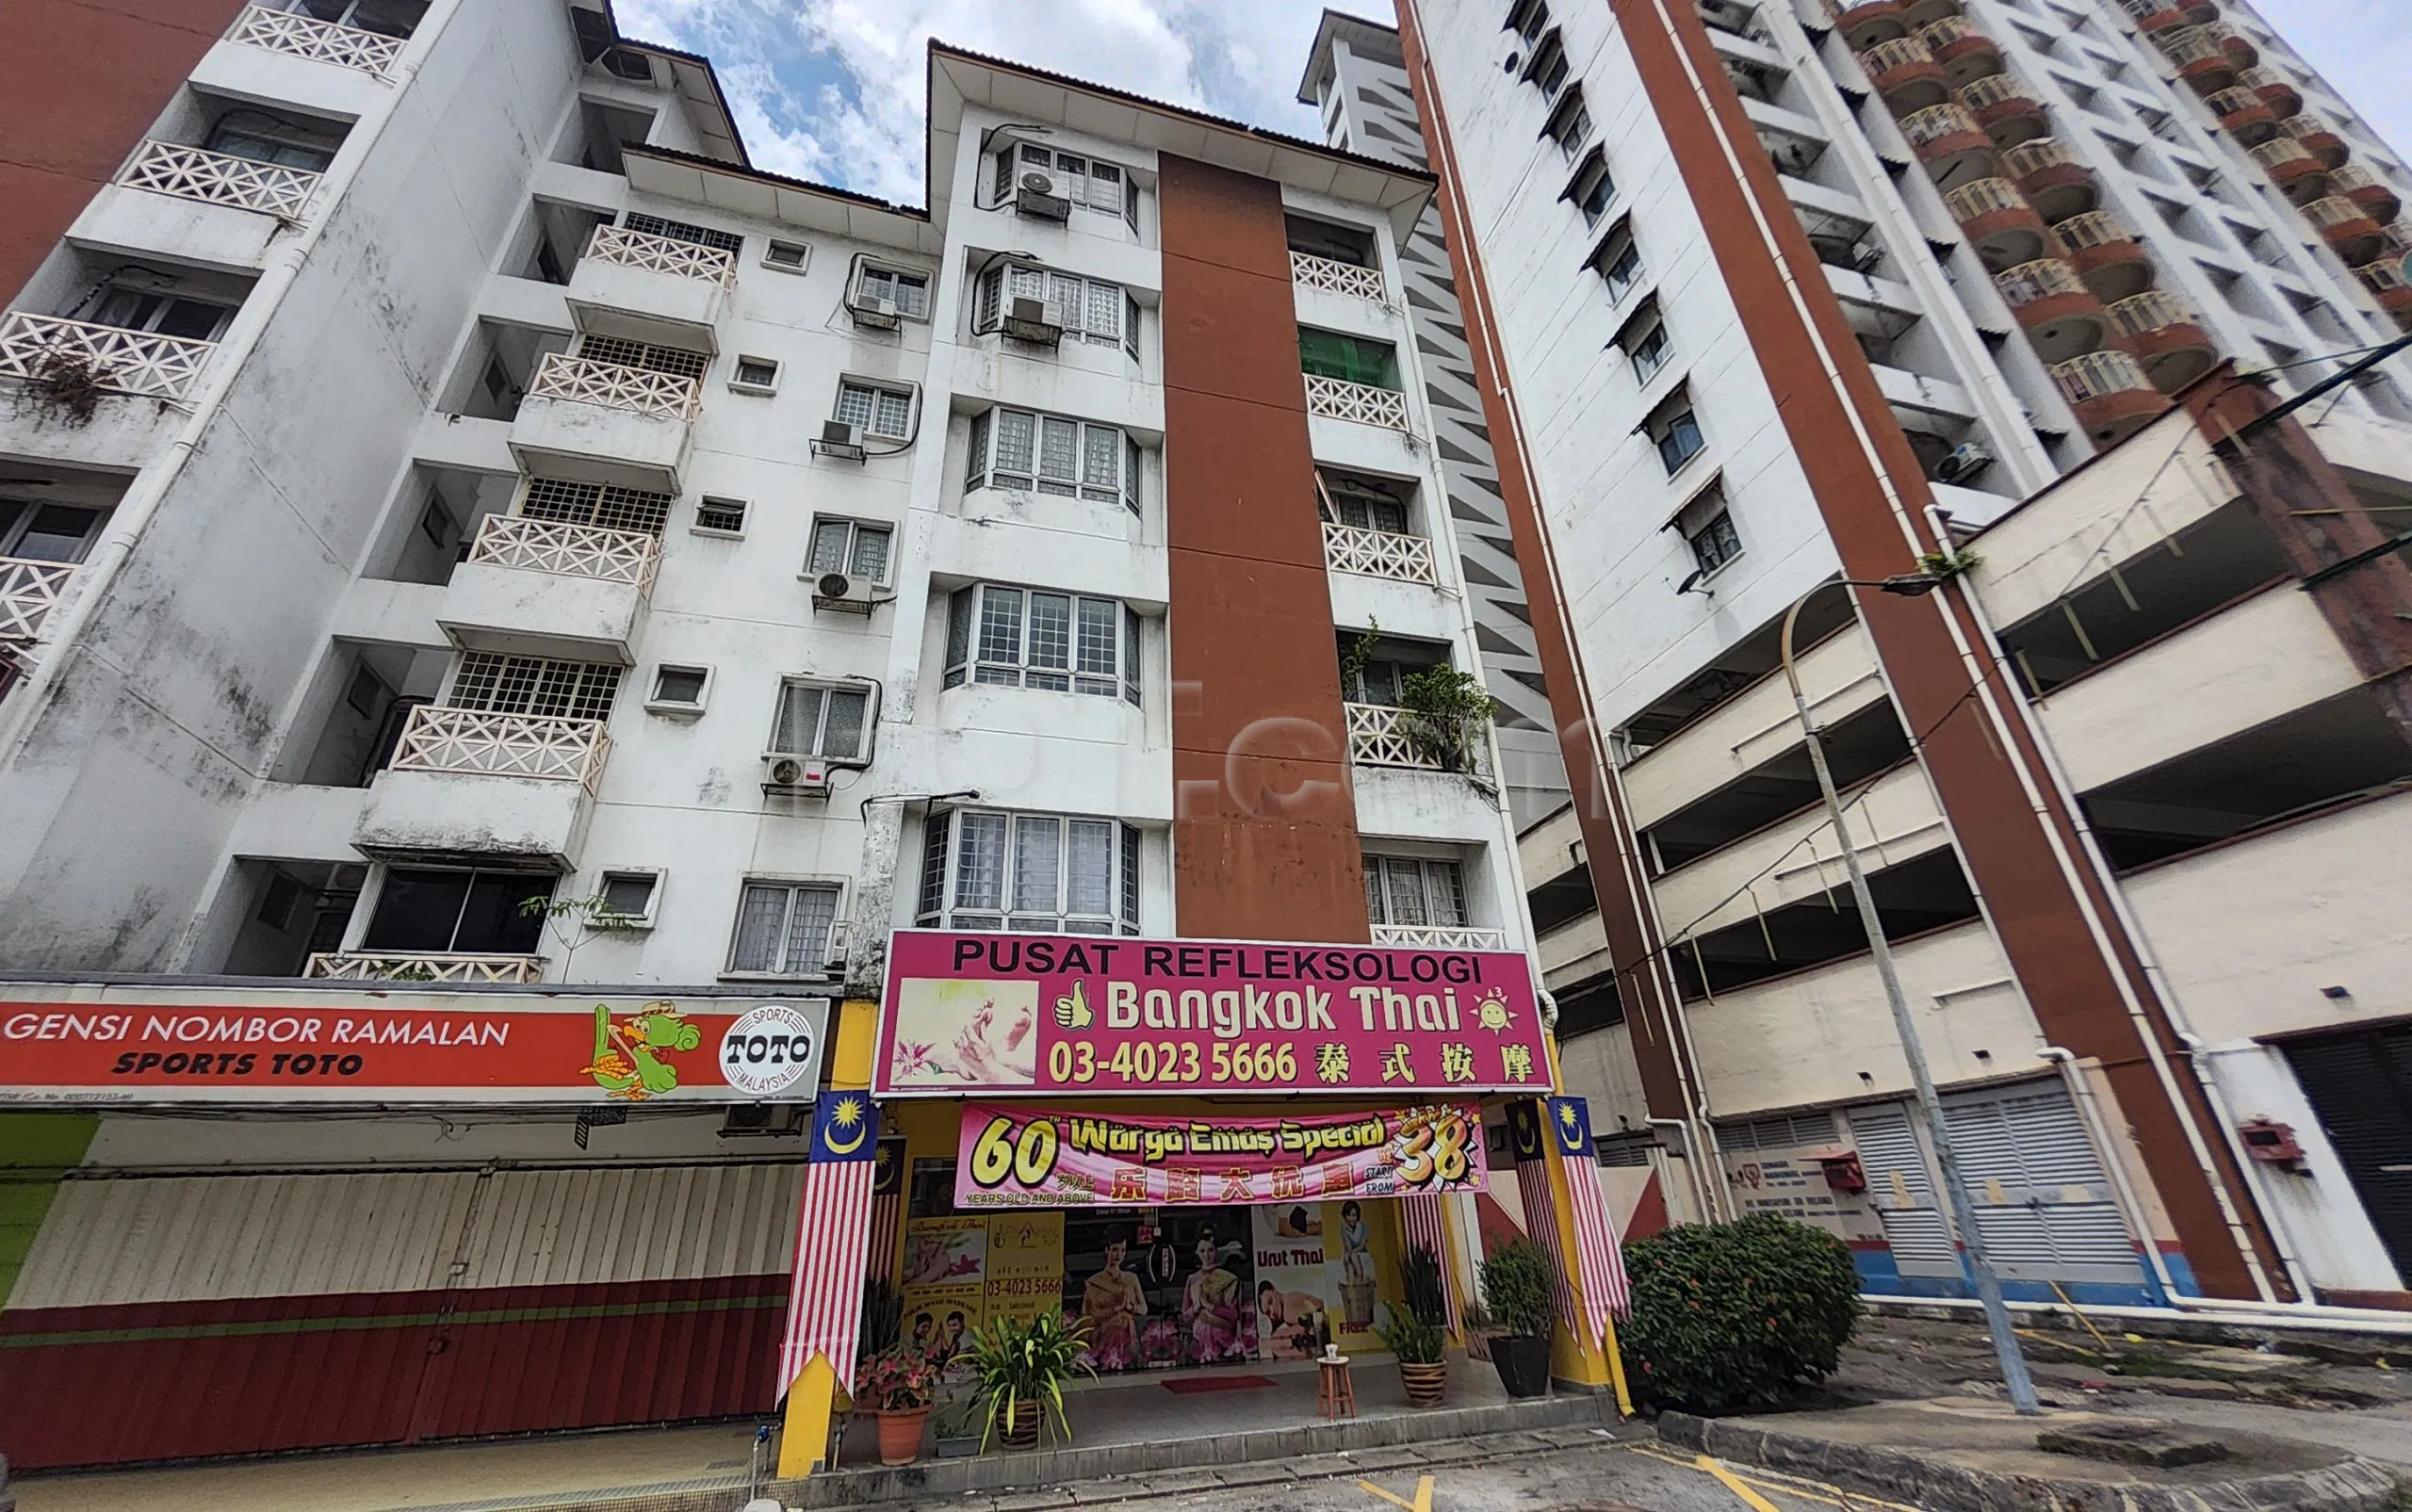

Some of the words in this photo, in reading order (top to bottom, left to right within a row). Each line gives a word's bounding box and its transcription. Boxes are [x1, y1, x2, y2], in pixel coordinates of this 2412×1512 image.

[953, 938, 1118, 975] PUSAT
[1144, 946, 1482, 984] REFLEKSOLOGI
[752, 1008, 794, 1025] SPORTS
[1107, 981, 1338, 1039] Bangkok
[1349, 986, 1462, 1032] Thai
[4, 1013, 134, 1041] GENSI
[140, 1015, 322, 1044] NOMBOR
[331, 1018, 510, 1048] RAMALAN
[726, 1034, 811, 1064] TOTO
[1049, 1040, 1202, 1083] 03-4023
[1211, 1041, 1298, 1084] 5666
[111, 1051, 256, 1076] SPORTS
[271, 1053, 364, 1076] TOTO
[1314, 1042, 1535, 1085] 泰式按摩
[735, 1072, 790, 1092] MALAYSIA
[970, 1115, 1060, 1189] 60
[1068, 1115, 1184, 1163] Warga
[1189, 1119, 1277, 1160] Emas
[1280, 1113, 1387, 1162] Special
[1395, 1114, 1469, 1183] 38
[1055, 1173, 1095, 1191] 岁以上
[1364, 1166, 1393, 1179] START
[966, 1193, 1004, 1205] YEARS
[1004, 1193, 1031, 1205] OLD
[1031, 1193, 1057, 1205] AND
[1056, 1193, 1095, 1205] ABOVE
[1365, 1181, 1394, 1195] FROM
[987, 1279, 1032, 1297] 03-4023
[1035, 1277, 1062, 1294] 5666
